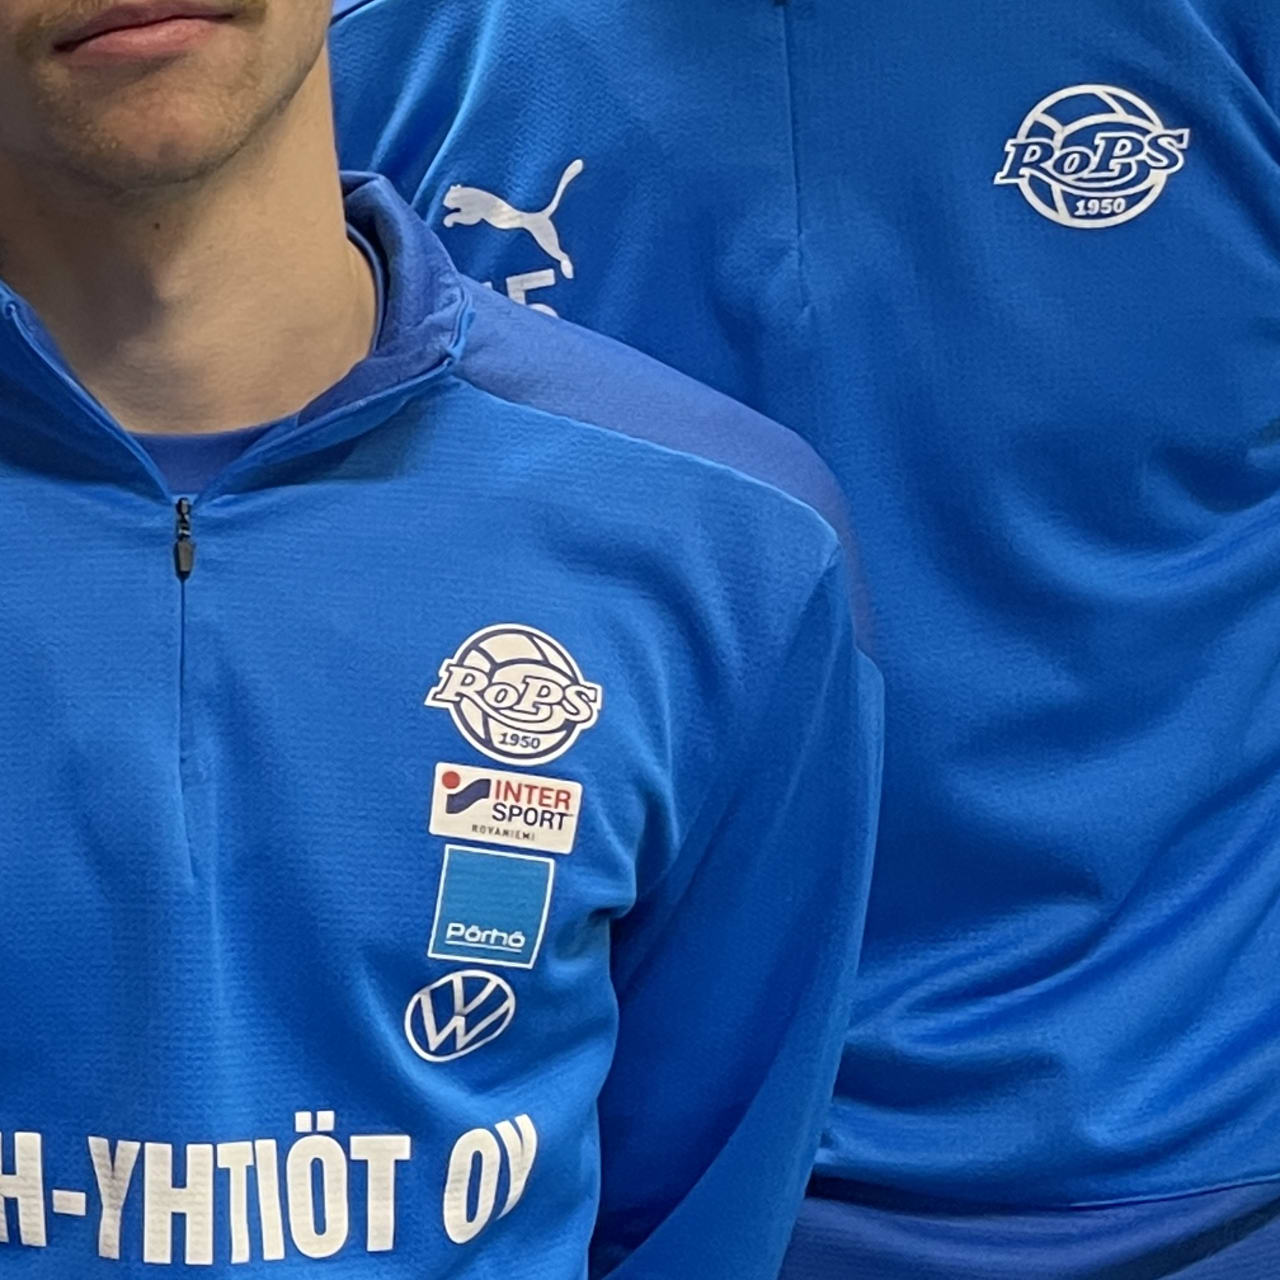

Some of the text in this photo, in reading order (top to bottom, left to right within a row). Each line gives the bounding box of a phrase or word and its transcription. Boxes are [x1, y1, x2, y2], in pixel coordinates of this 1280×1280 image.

[1074, 197, 1126, 217] 1950
[498, 732, 541, 750] 1950
[495, 780, 572, 811] INTER
[492, 802, 570, 831] SPORT
[471, 824, 536, 841] ROVANIEMI
[443, 1114, 538, 1244] OY
